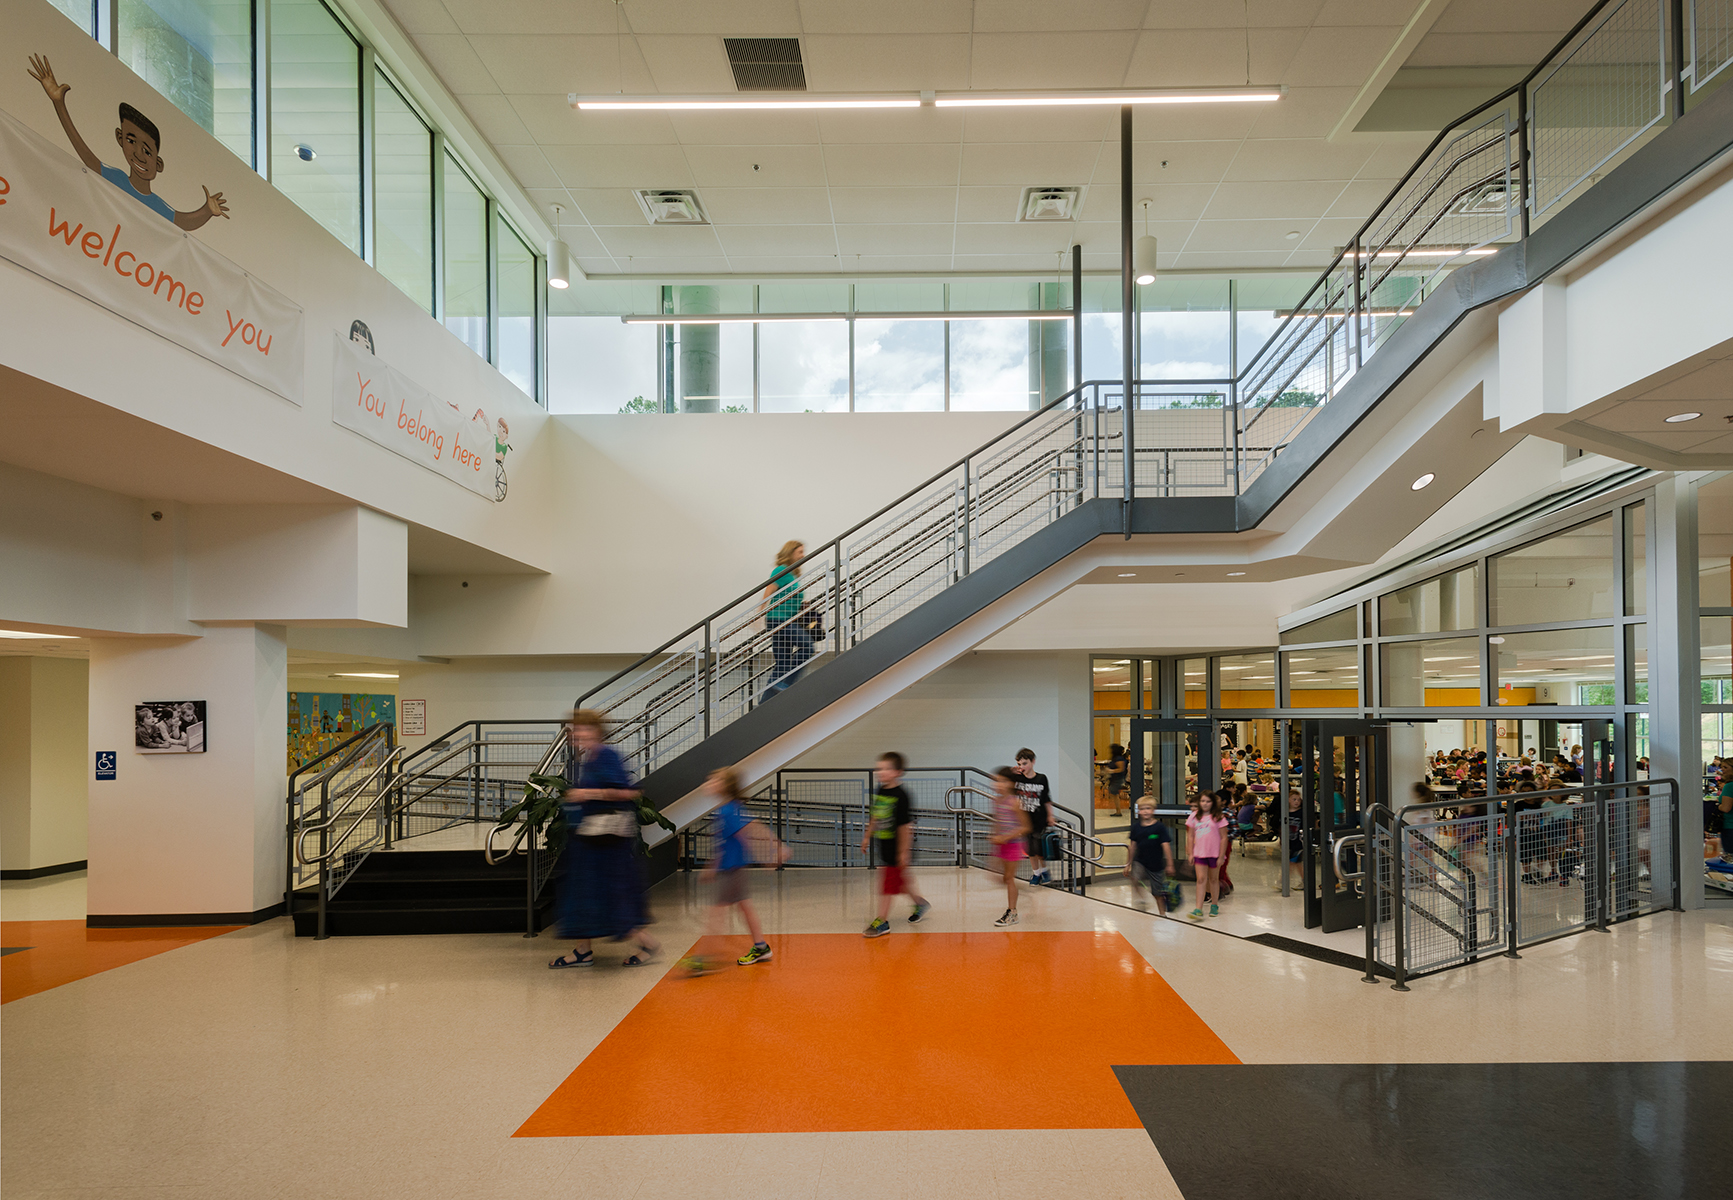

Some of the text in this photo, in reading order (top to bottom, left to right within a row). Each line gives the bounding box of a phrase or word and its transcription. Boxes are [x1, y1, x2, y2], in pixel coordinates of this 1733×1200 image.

[49, 207, 272, 356] welcome you
[357, 371, 482, 471] You belong here
